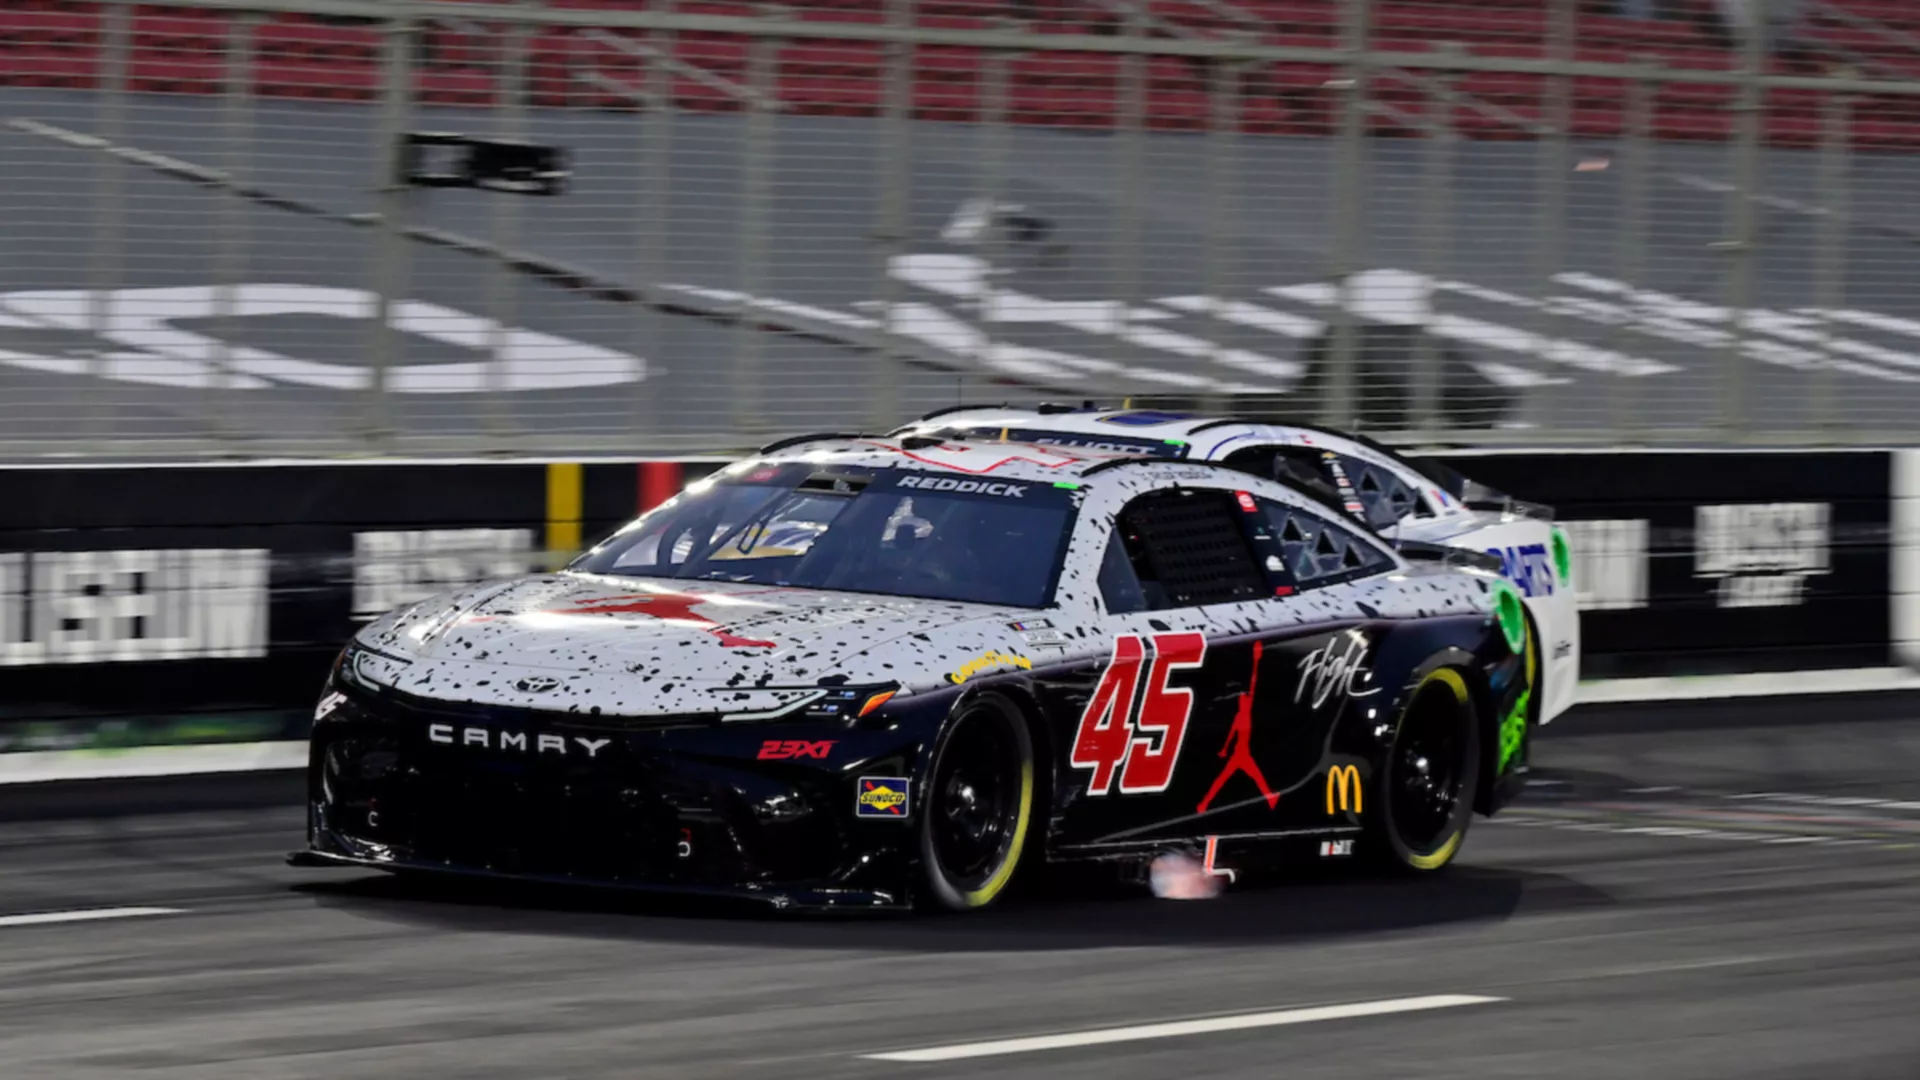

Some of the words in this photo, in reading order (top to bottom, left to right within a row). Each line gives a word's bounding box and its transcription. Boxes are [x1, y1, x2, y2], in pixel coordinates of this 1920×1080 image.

[897, 475, 1028, 498] REDDICK
[1070, 630, 1208, 797] 45
[429, 723, 611, 757] CAMRY
[861, 792, 906, 804] SUNOCO
